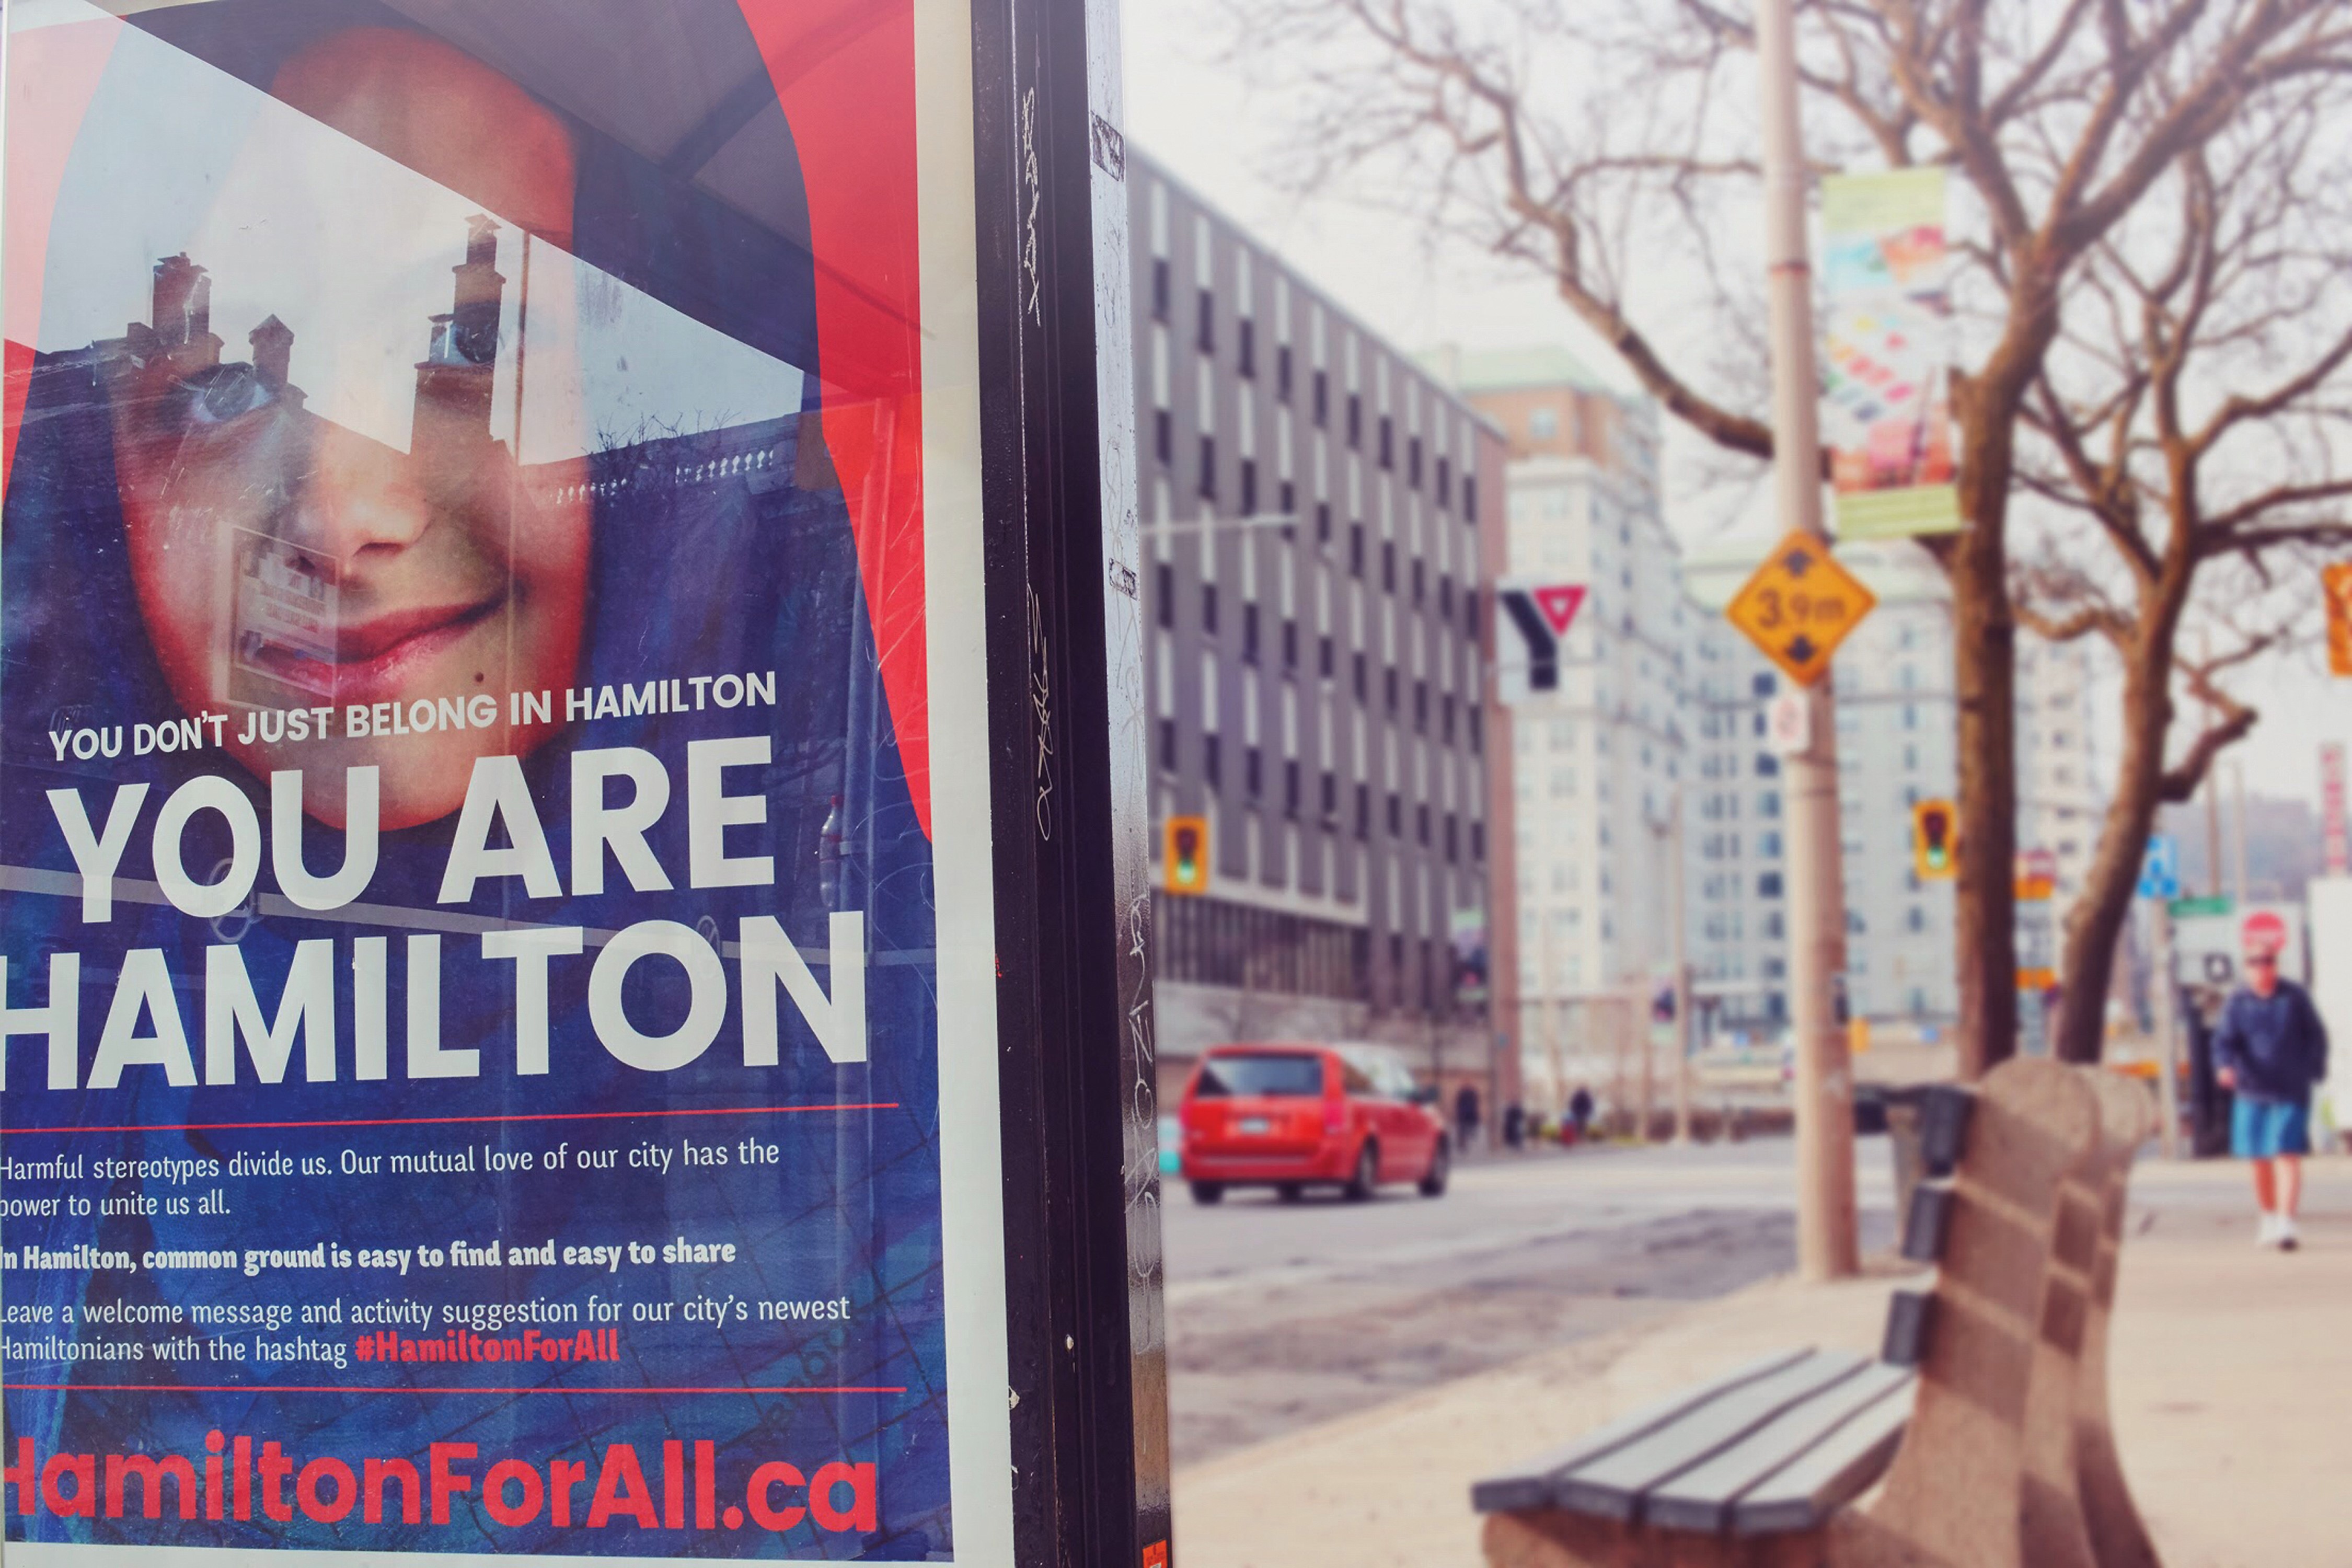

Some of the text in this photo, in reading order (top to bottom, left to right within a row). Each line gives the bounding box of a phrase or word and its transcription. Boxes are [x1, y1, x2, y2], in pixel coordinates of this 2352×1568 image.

[49, 671, 776, 761] YOU DON'T JUST BELONG IN HAMILTON
[46, 735, 775, 924] YOU ARE
[0, 910, 868, 1091] HAMILTON
[0, 1137, 779, 1185] Harmful stereotypes divide us. Our mutual love of our city has the
[68, 1195, 90, 1216] to
[101, 1193, 157, 1216] unite
[167, 1197, 190, 1215] us
[199, 1189, 230, 1215] all.
[24, 1244, 137, 1274] Hamilton,
[143, 1250, 237, 1269] common
[244, 1242, 326, 1276] ground
[331, 1242, 352, 1269] is
[358, 1249, 411, 1275] easy
[417, 1245, 444, 1267] to
[450, 1240, 502, 1266] find
[509, 1239, 557, 1266] and
[563, 1246, 622, 1273] easy
[628, 1241, 656, 1264] to
[663, 1237, 736, 1264] share
[62, 1305, 74, 1323] a
[83, 1298, 182, 1323] welcome
[191, 1305, 292, 1331] message
[302, 1298, 342, 1323] and
[352, 1296, 433, 1331] activity
[443, 1296, 578, 1331] suggestion
[588, 1295, 622, 1322] for
[633, 1302, 674, 1322] our
[684, 1294, 748, 1329] city's
[758, 1296, 850, 1321] newest
[153, 1334, 200, 1361] with
[209, 1335, 246, 1361] the
[257, 1335, 348, 1369] hashtag
[355, 1329, 619, 1362] #HamiltonForAll
